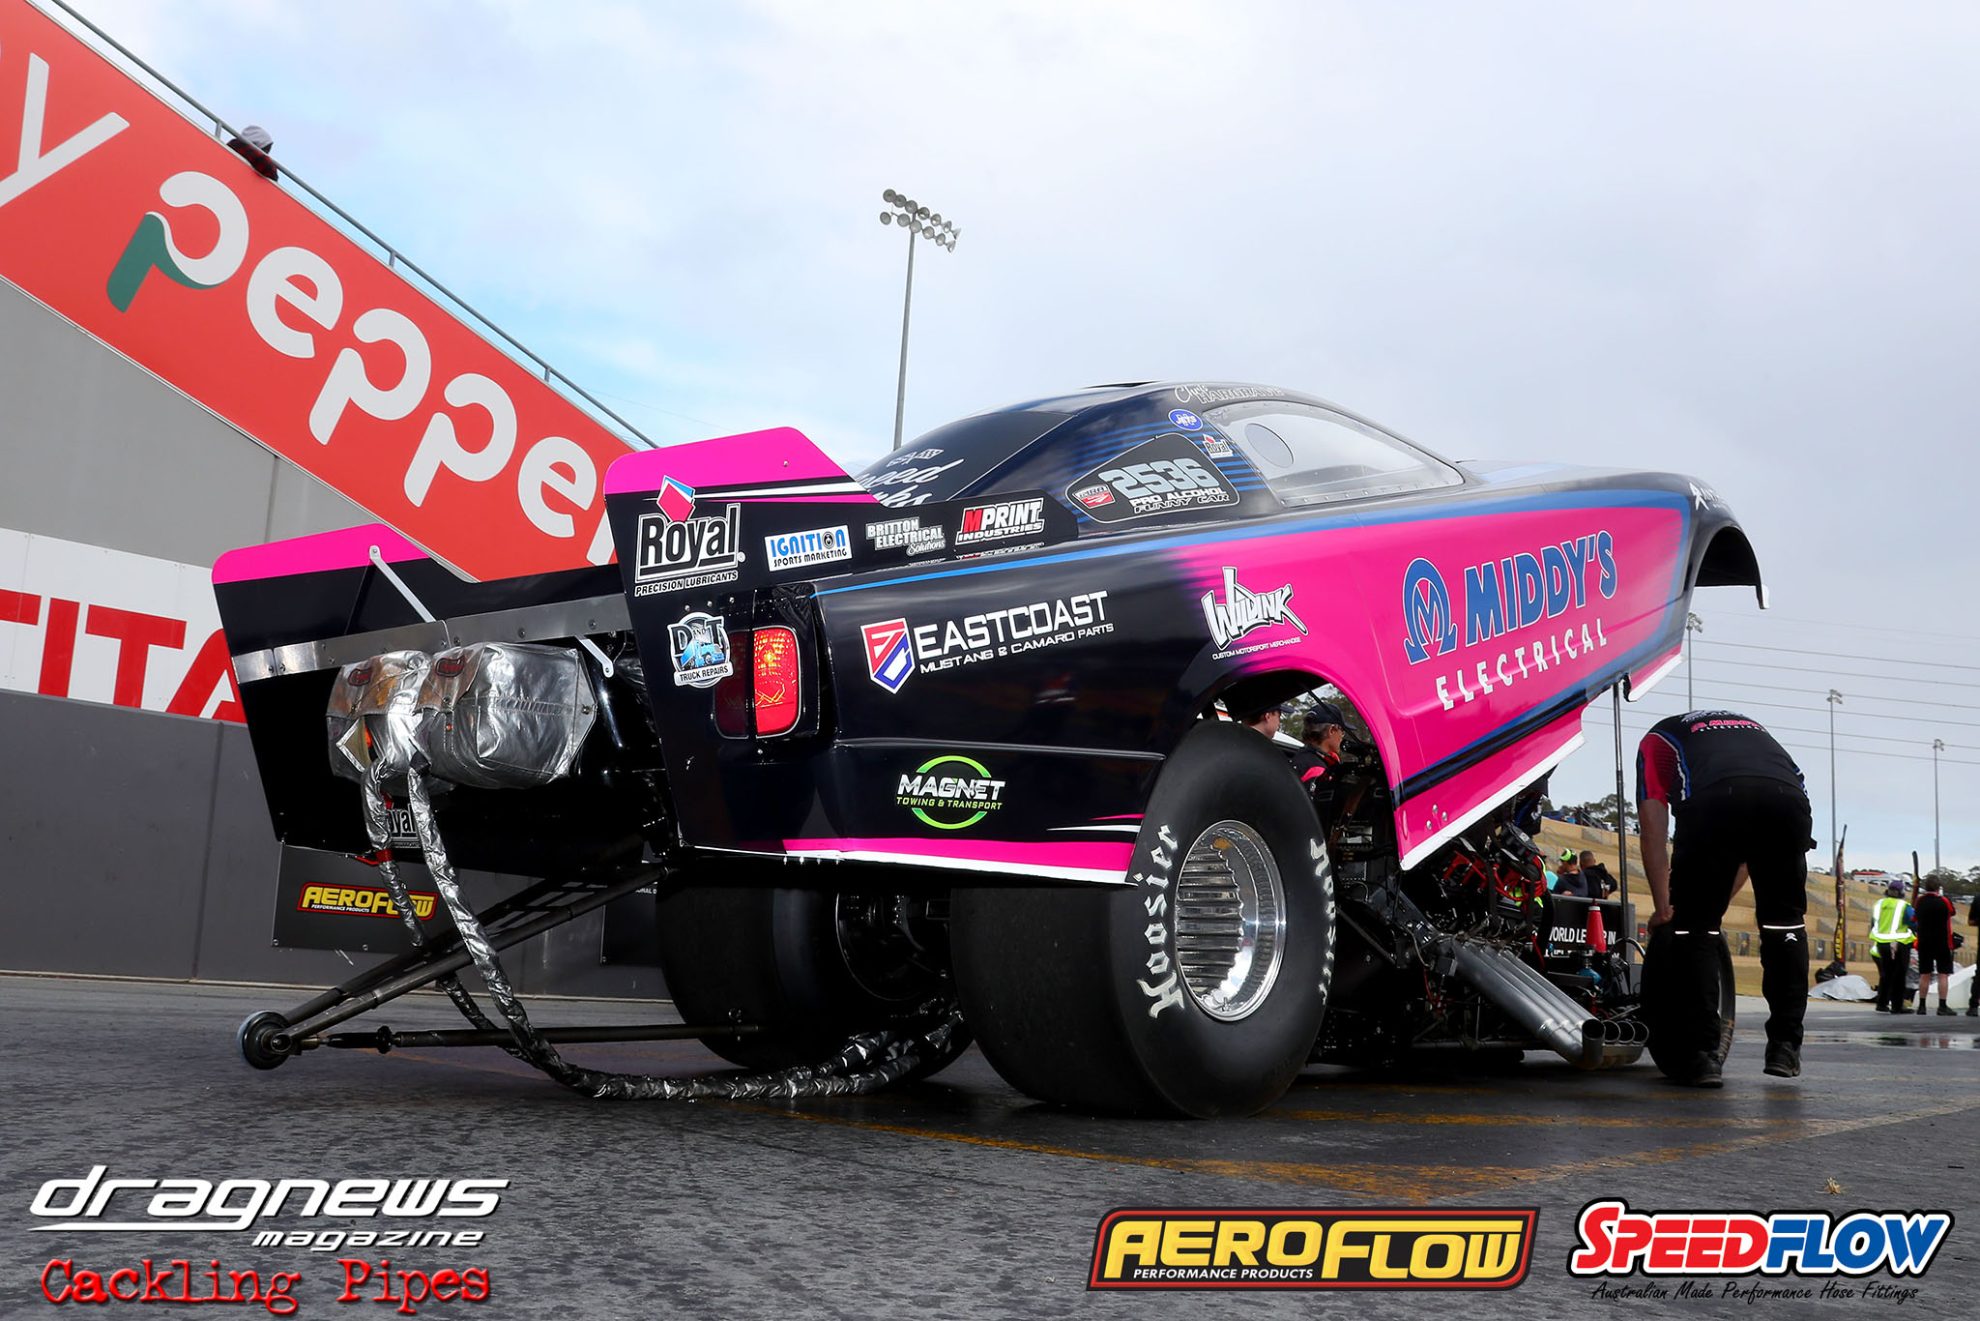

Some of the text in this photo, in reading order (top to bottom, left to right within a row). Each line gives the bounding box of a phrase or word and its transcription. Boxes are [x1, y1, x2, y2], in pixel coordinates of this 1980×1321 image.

[1098, 458, 1220, 499] 2536
[1129, 487, 1227, 507] PRO ALCOHOL
[1134, 493, 1230, 514] FUNNY CAR
[867, 519, 919, 538] BRITTON
[962, 500, 1043, 534] MPRINT
[637, 503, 741, 581] Royal
[876, 527, 944, 549] ELECTRICAL
[957, 522, 1043, 542] INDUSTRIES
[773, 548, 847, 567] SPORTS MARKETING
[908, 540, 946, 555] Solutions
[635, 570, 738, 597] PRECISION LUBRICANTS
[1463, 530, 1618, 648] MIDDY'S
[913, 590, 1109, 660] EASTCOAST
[920, 623, 1115, 674] MUSTANG & CAMARO PARTS
[1212, 650, 1235, 660] CUSTOM
[680, 665, 729, 682] TRUCK REPAIRS
[1435, 618, 1608, 711] ELECTRICAL
[897, 774, 1006, 801] MAGNET
[896, 796, 935, 807] TOWING
[947, 800, 1003, 810] TRANSPORT
[301, 886, 435, 917] AEROFLW
[311, 903, 370, 913] PERFORMANCE PRODUCTS
[1136, 825, 1185, 1018] Hoosier
